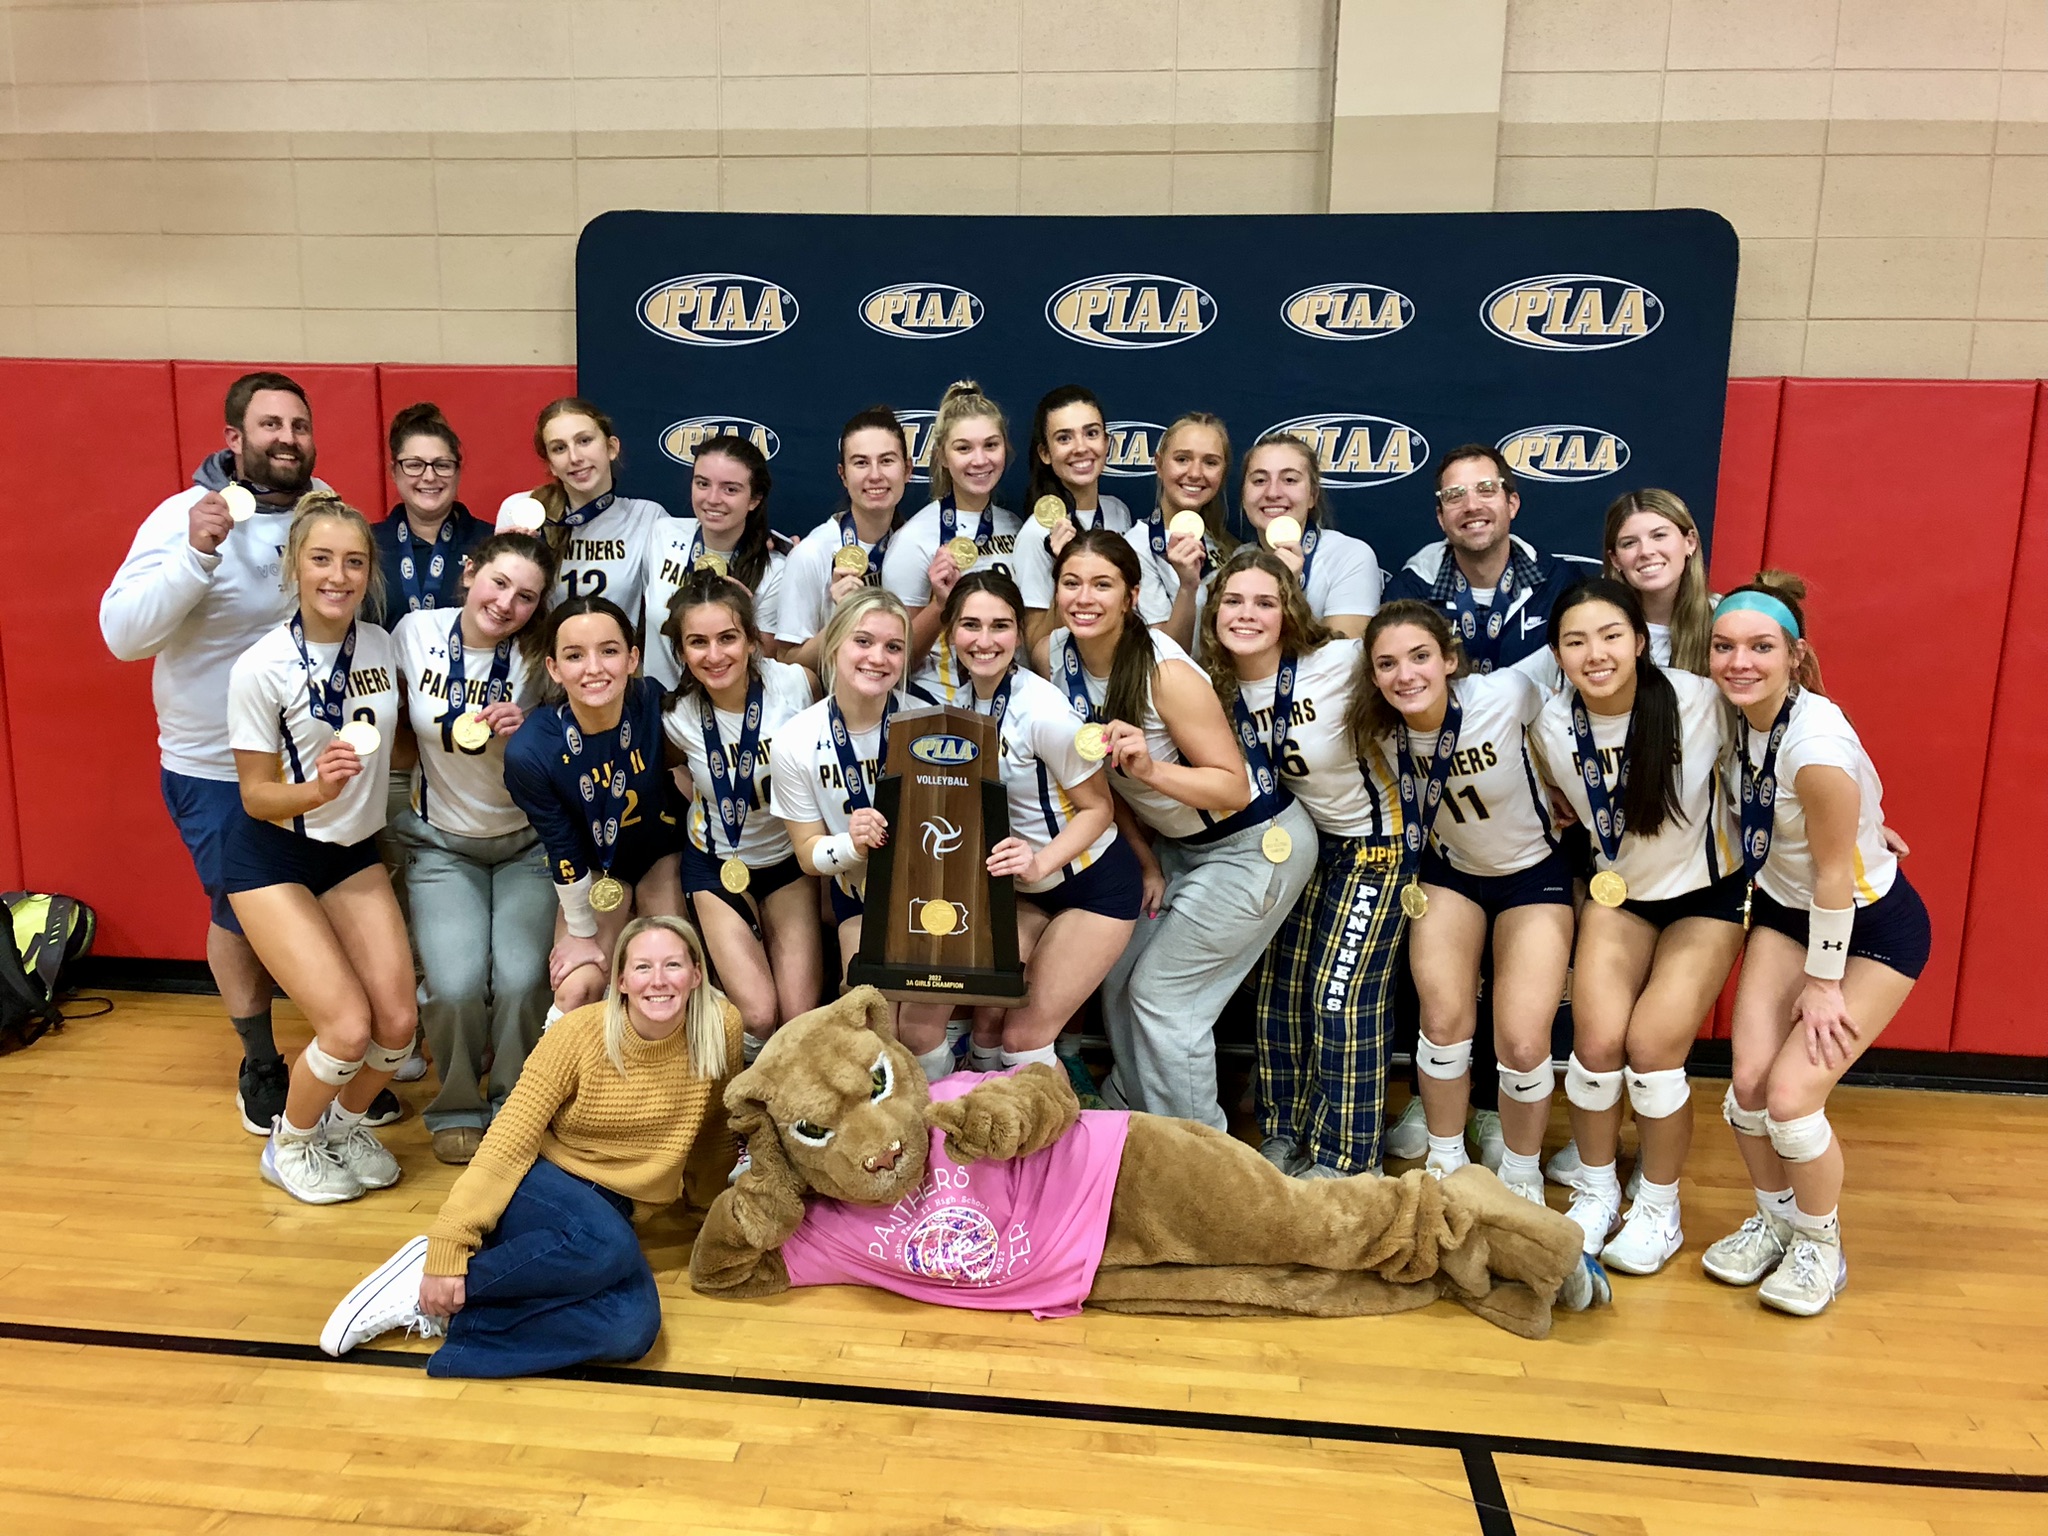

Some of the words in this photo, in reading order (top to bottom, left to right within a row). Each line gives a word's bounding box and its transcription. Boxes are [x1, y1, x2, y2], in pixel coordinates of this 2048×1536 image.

[662, 286, 787, 332] PIAA
[878, 293, 976, 329] PIAA
[1072, 286, 1203, 334] PIAA
[1301, 293, 1404, 329] PIAA
[1508, 288, 1648, 336] PIAA
[1516, 435, 1618, 470] PIAA
[918, 738, 974, 760] PIAA
[916, 775, 969, 786] VOLLEYBALL
[1326, 884, 1378, 1011] PANTHERS
[932, 980, 964, 989] CHAMPION
[868, 1165, 970, 1260] PANTHERS
[935, 1196, 956, 1206] High
[961, 1195, 990, 1212] School
